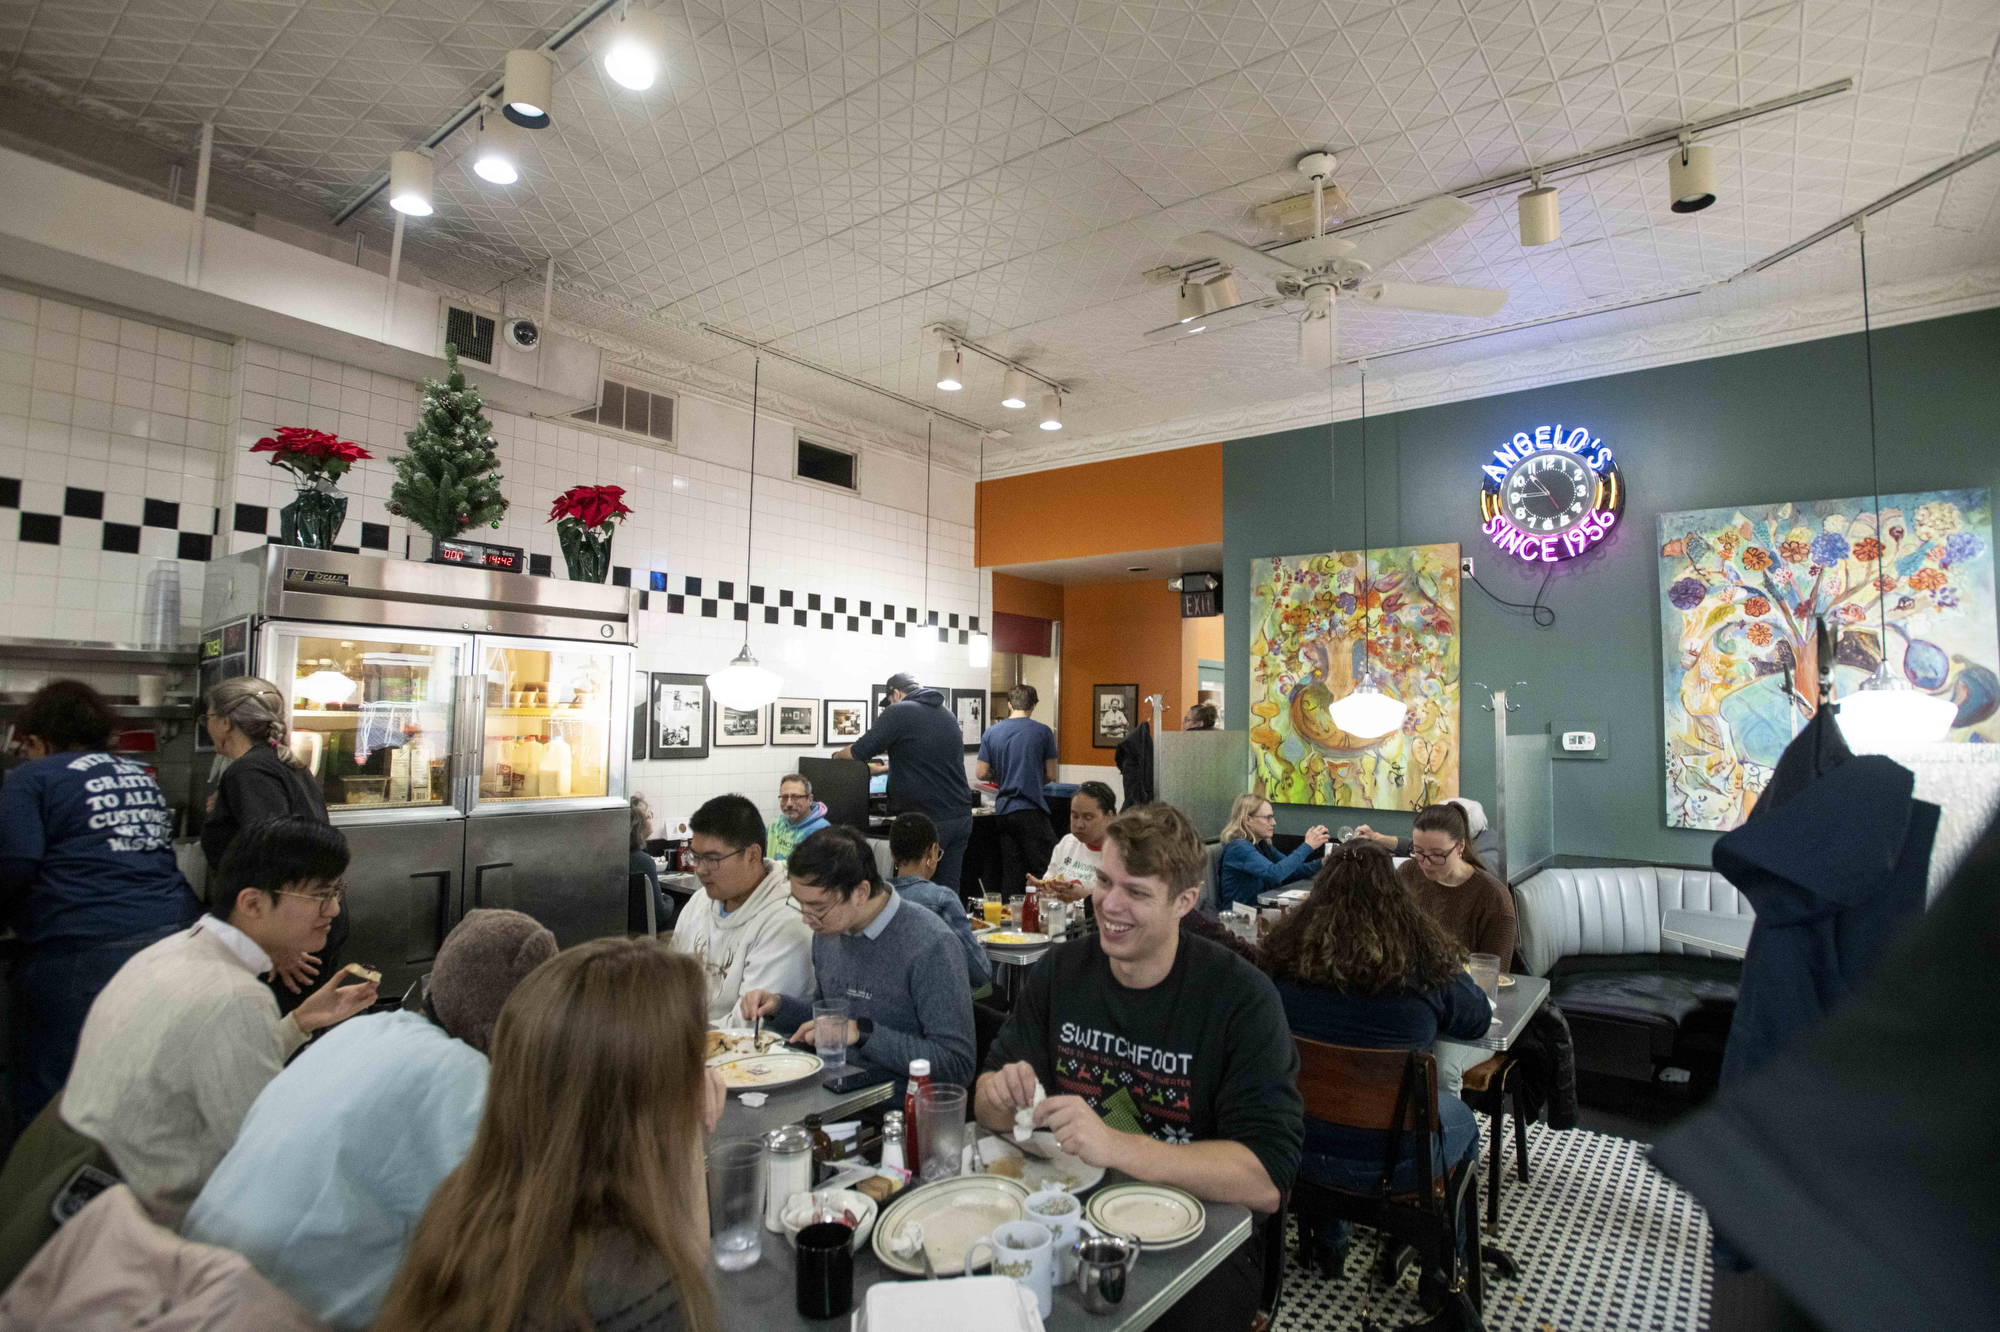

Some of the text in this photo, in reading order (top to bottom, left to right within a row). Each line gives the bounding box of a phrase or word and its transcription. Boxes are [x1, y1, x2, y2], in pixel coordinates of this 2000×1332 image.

[1482, 424, 1613, 482] ANGELO'S
[1527, 463, 1537, 474] 11
[1542, 457, 1556, 469] 12
[1561, 459, 1567, 471] 1
[1573, 468, 1583, 481] 2
[1513, 475, 1526, 488] 10
[1576, 484, 1586, 497] 3
[1510, 492, 1521, 504] 9
[1515, 507, 1526, 520] 8
[1571, 501, 1582, 514] 4
[1527, 517, 1536, 529] 7
[1542, 518, 1554, 531] 6
[1560, 514, 1571, 527] 5
[1482, 508, 1615, 562] SINCE 1956
[1185, 593, 1211, 616] EXIT
[86, 794, 119, 811] TO
[124, 791, 157, 806] ALL
[1060, 1022, 1193, 1075] SWITCHFOOT
